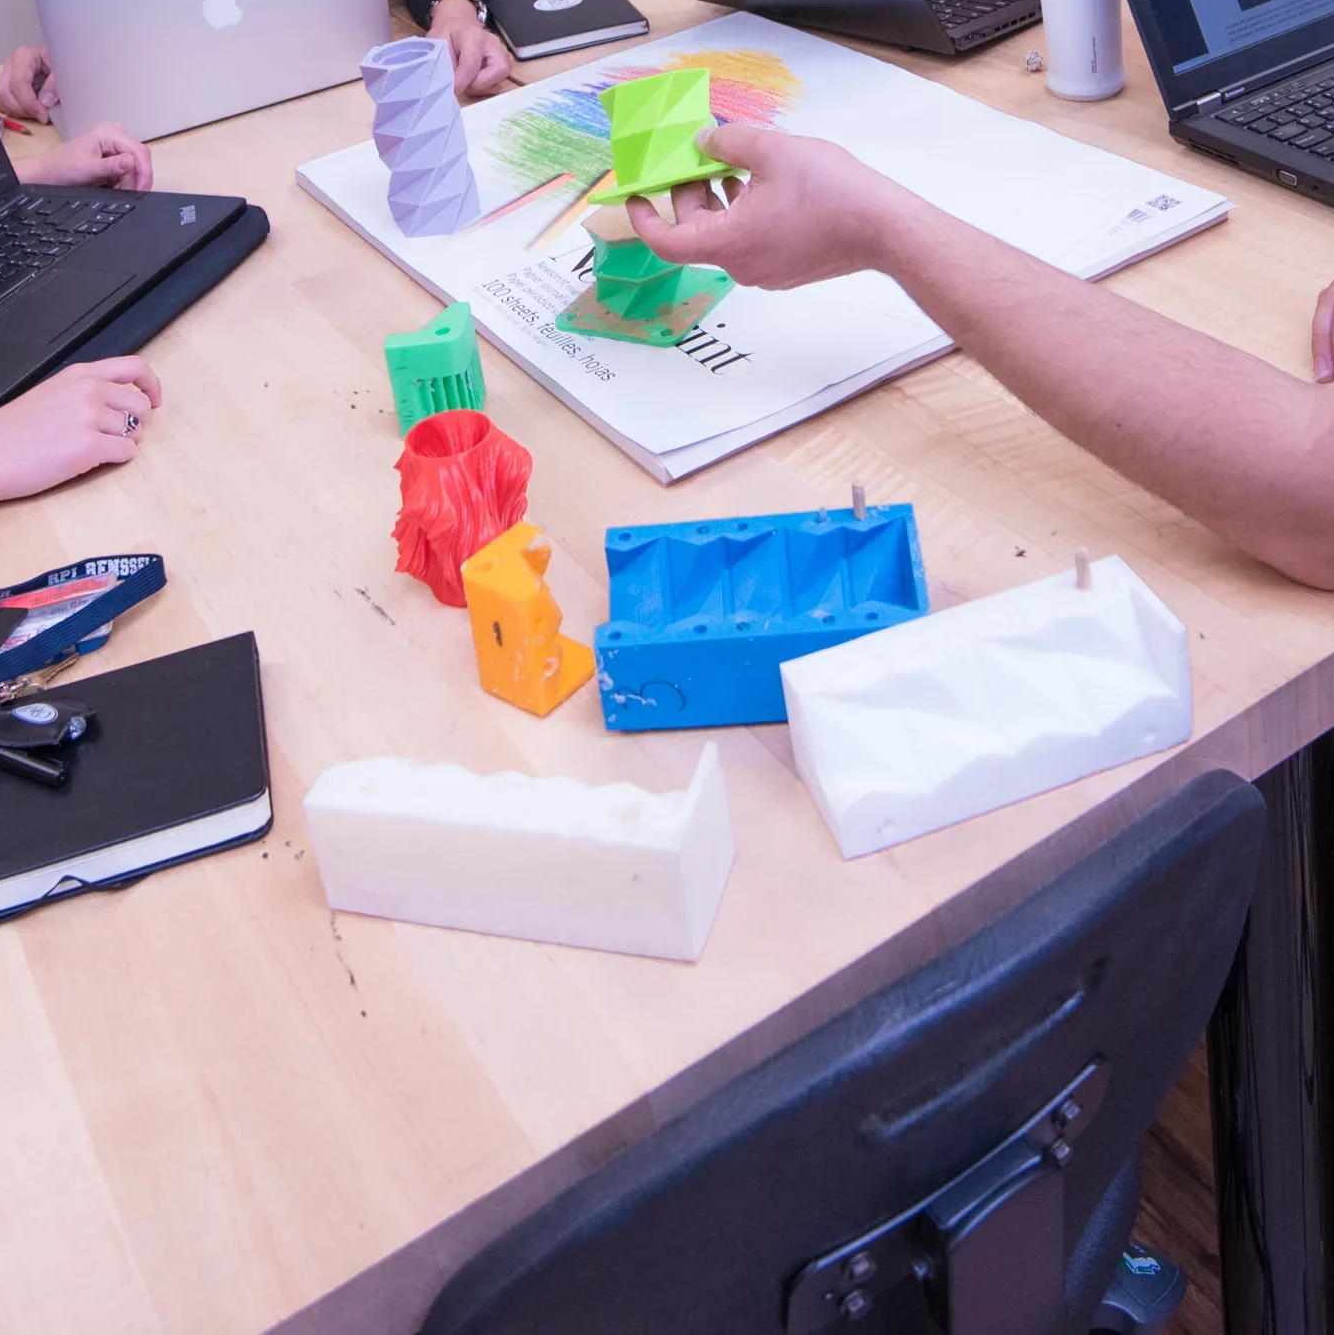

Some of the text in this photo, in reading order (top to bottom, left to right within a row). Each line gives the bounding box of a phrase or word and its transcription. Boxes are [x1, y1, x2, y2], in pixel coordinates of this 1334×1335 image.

[481, 279, 512, 297] 100
[500, 295, 540, 326] sheets,
[535, 322, 582, 359] feuilles,
[578, 352, 616, 382] hojas
